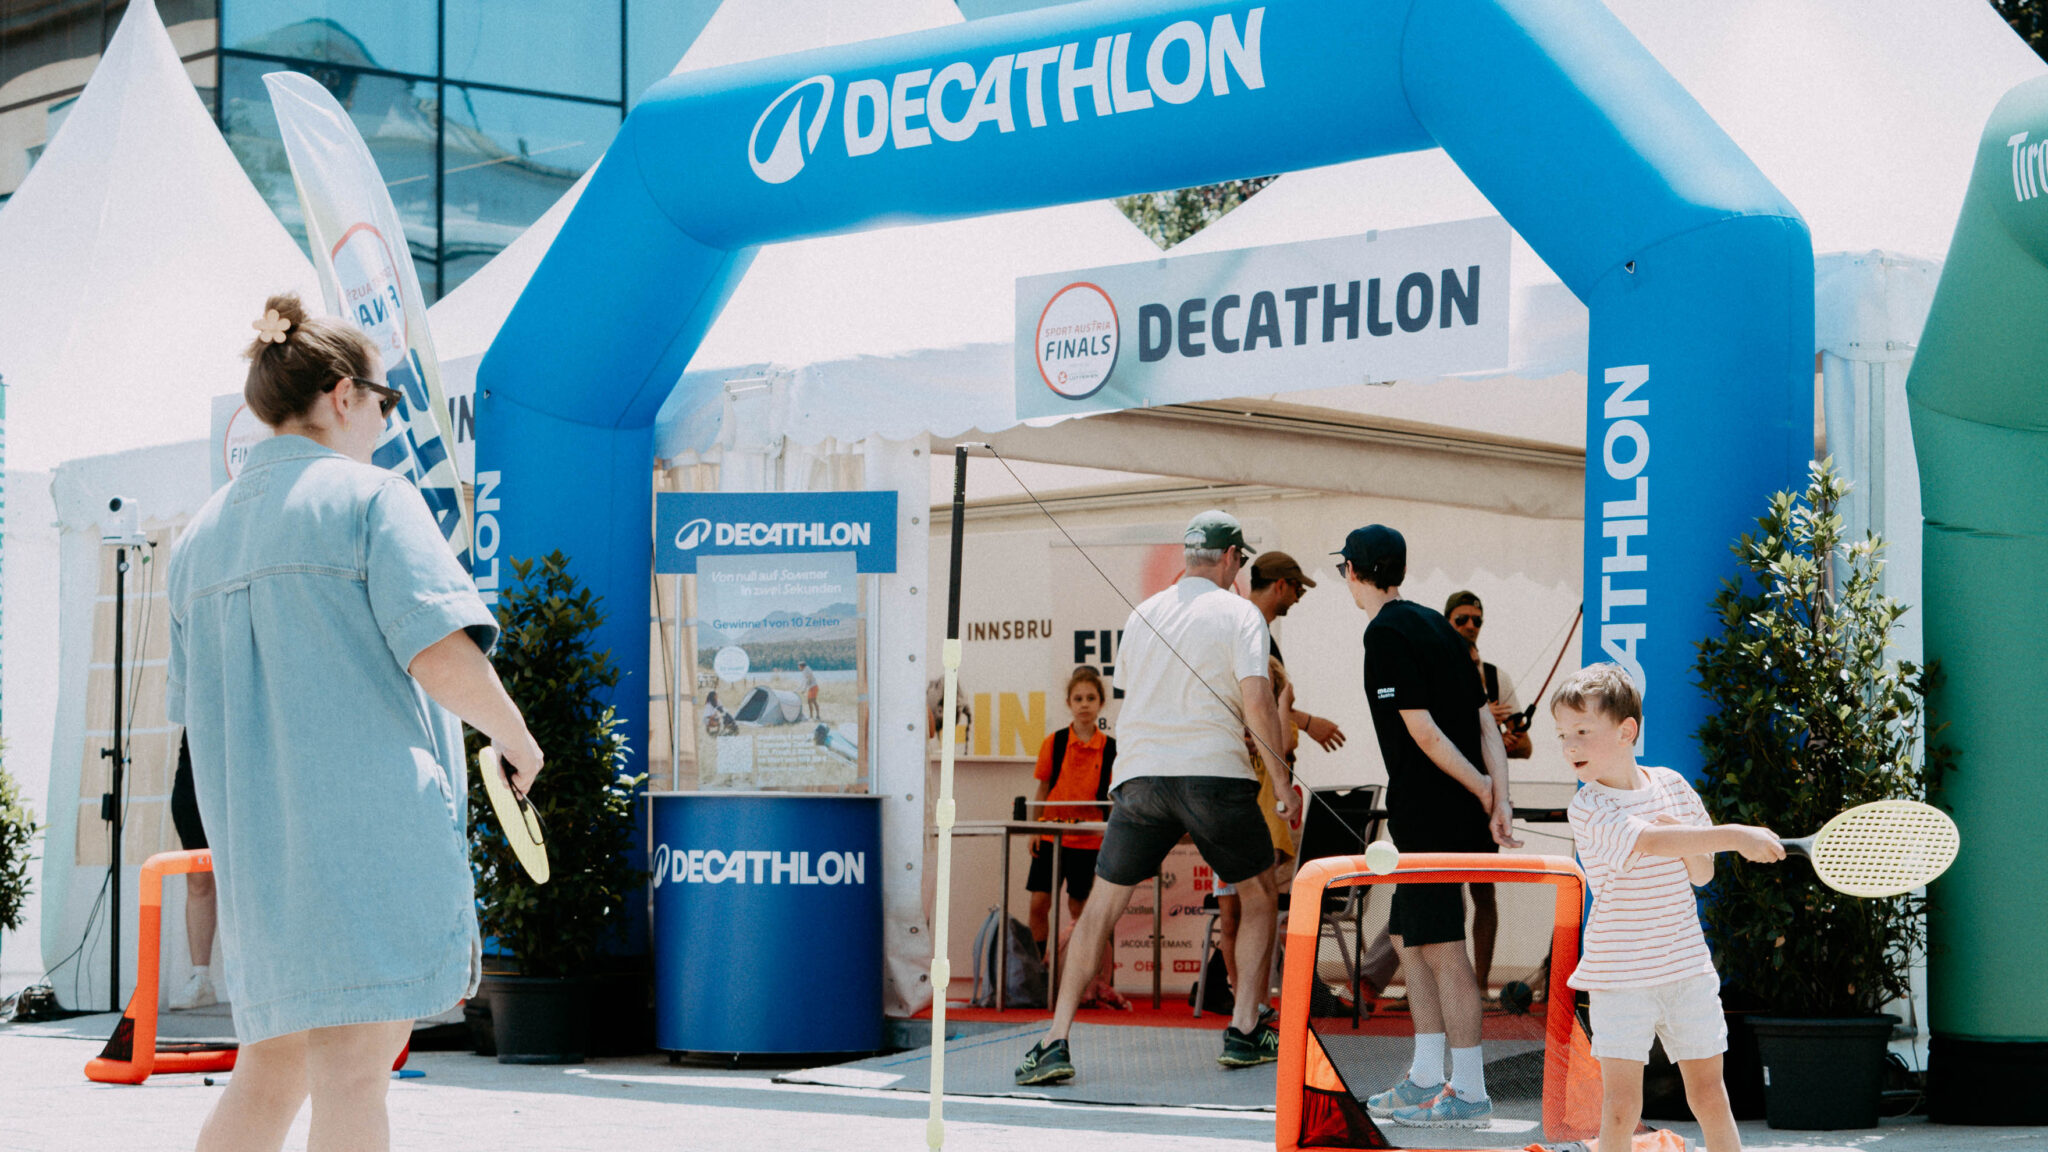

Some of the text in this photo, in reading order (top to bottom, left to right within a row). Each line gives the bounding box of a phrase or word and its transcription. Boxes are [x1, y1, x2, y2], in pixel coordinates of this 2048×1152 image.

[843, 6, 1267, 158] DECATHLON
[1138, 264, 1481, 363] DECATHLON
[1044, 320, 1112, 338] SPORT AUSTRIA
[1045, 334, 1112, 362] FINALS
[715, 522, 871, 547] DECATHLON
[783, 583, 842, 595] Sekunden
[713, 618, 760, 630] Gewinne
[769, 619, 789, 628] von
[791, 617, 803, 628] 10
[967, 619, 1053, 642] INNSBRU
[672, 849, 865, 885] DECATHLON
